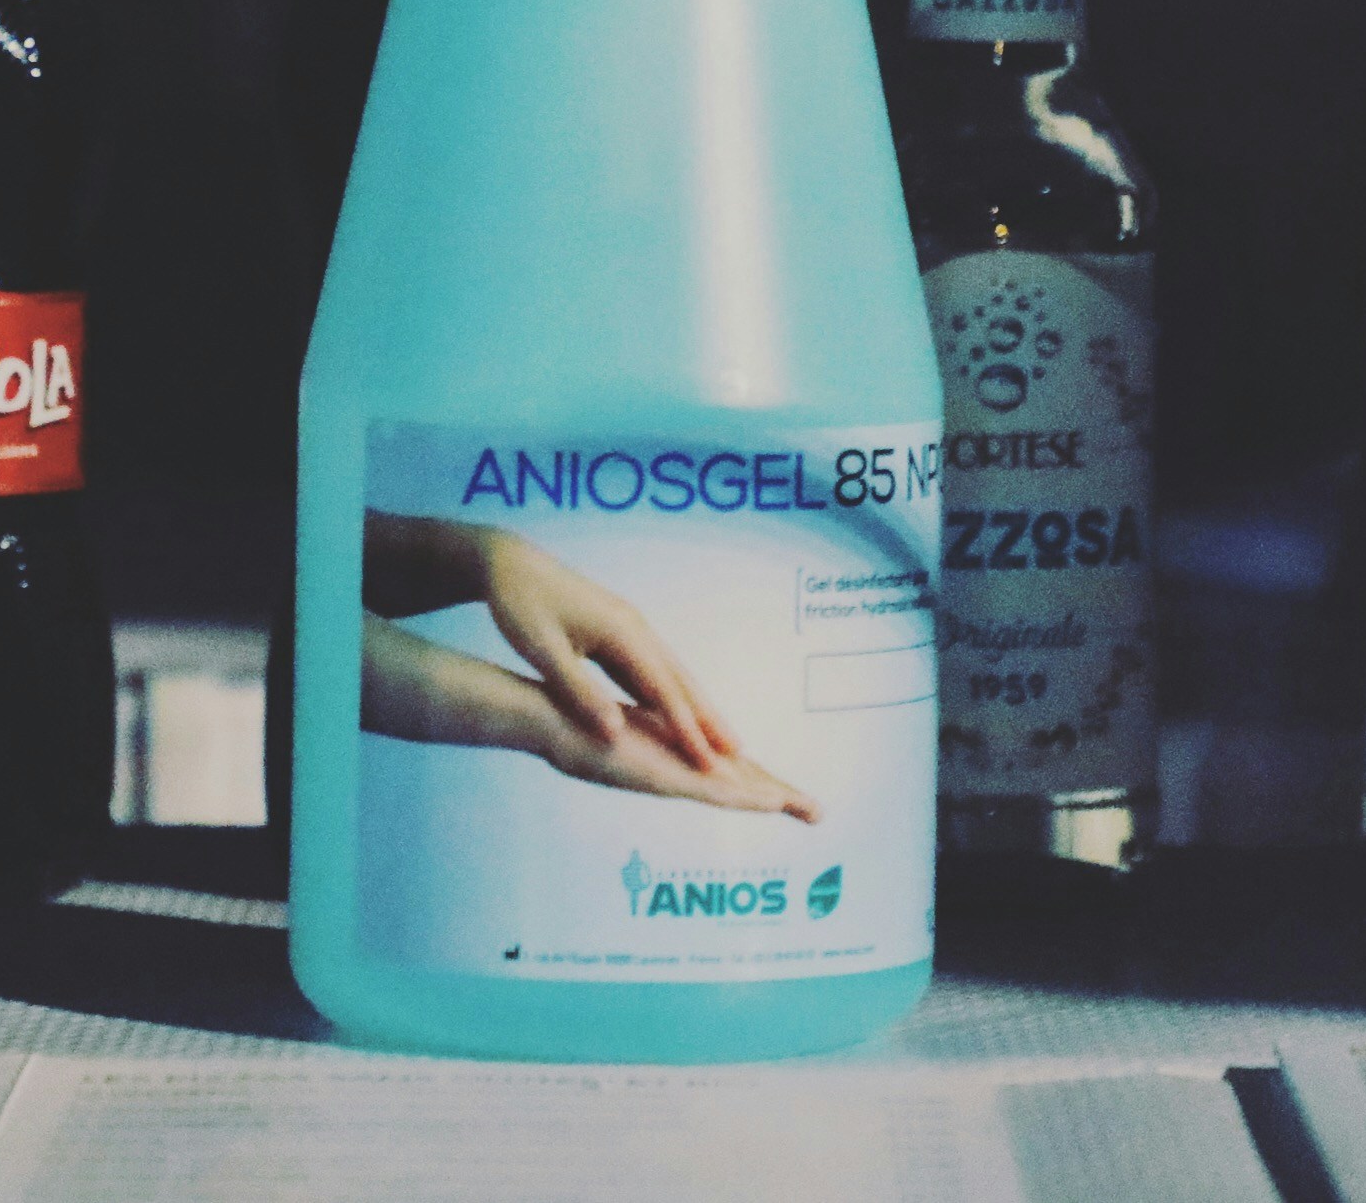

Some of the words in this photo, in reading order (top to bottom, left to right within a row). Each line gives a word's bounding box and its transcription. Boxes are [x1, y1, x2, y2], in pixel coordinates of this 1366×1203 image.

[946, 430, 1083, 469] ORTESE
[461, 446, 827, 512] ANIOSGEL
[835, 447, 896, 507] 85
[970, 671, 1049, 706] 1959
[647, 879, 788, 917] ANIOS
